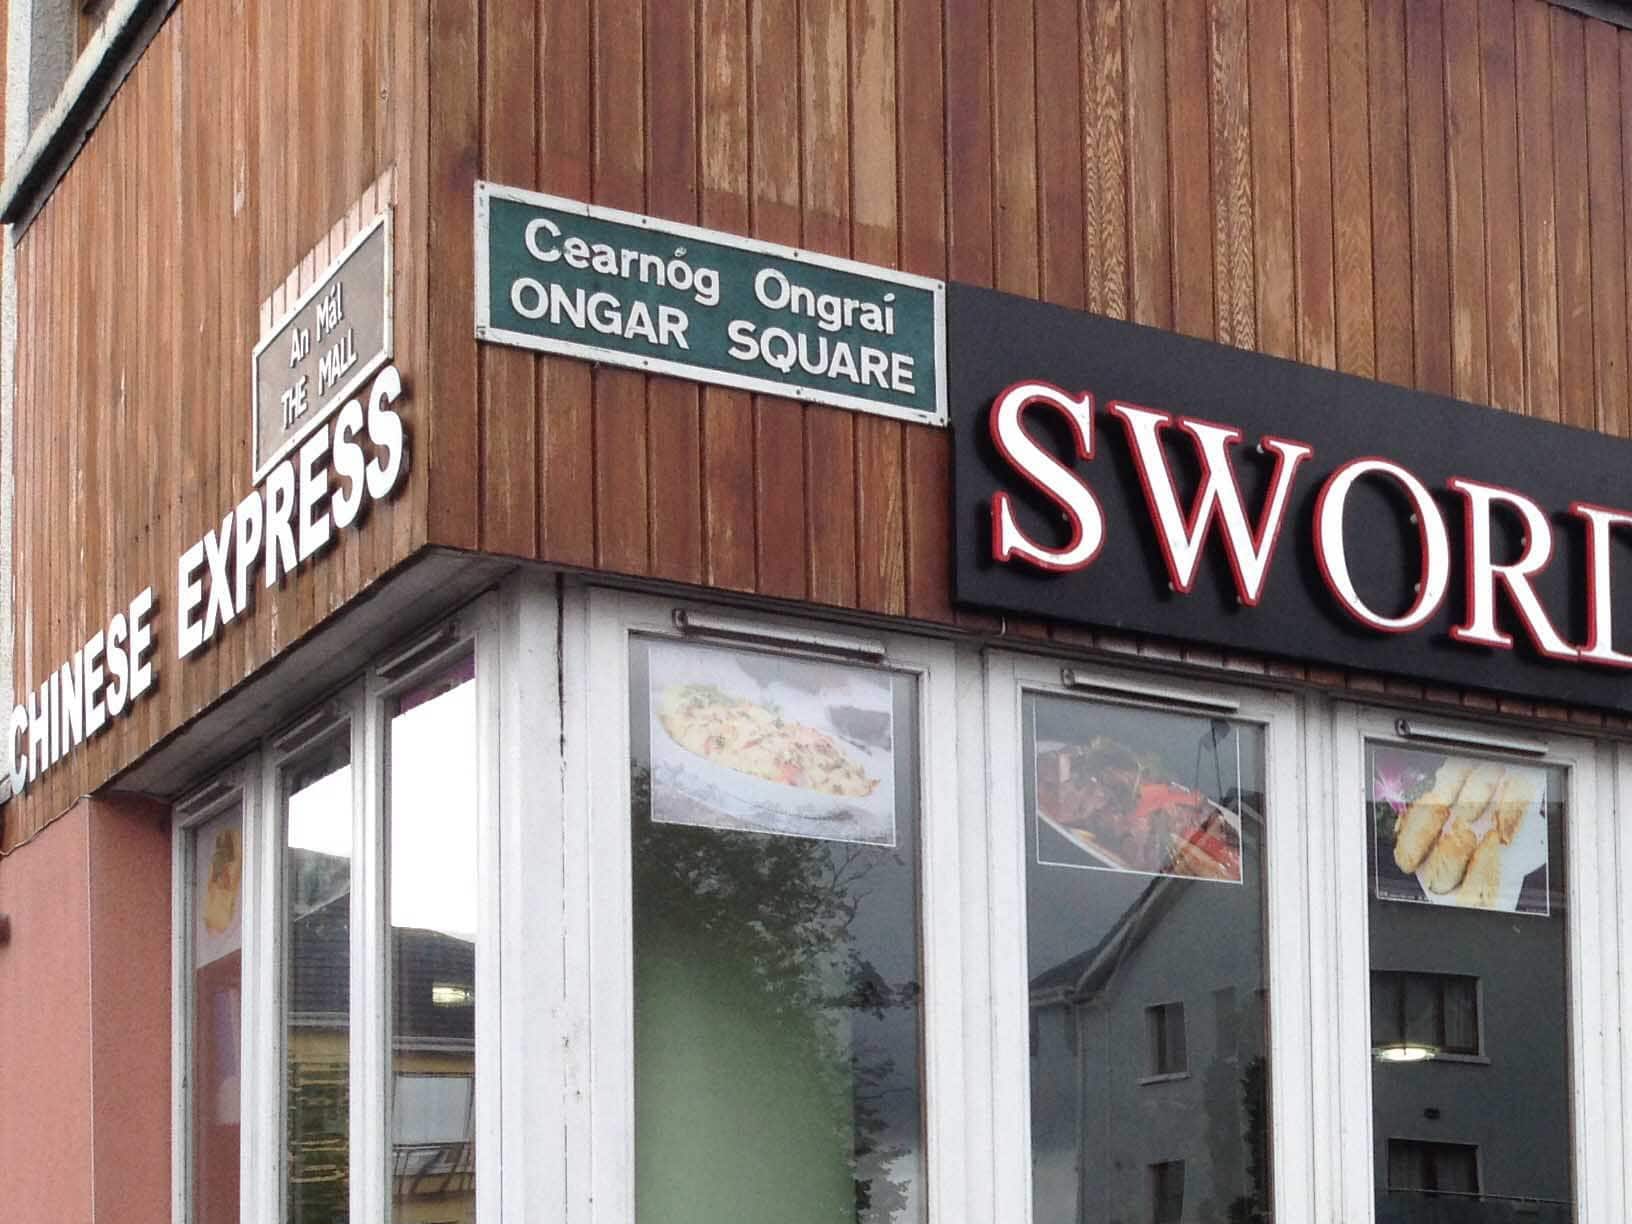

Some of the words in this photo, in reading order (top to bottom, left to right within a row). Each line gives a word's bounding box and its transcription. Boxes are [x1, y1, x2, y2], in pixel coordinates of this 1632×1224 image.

[290, 328, 310, 367] An
[316, 282, 343, 341] Mál
[525, 218, 720, 306] Cearnóg
[754, 269, 896, 335] Ongraí
[281, 376, 308, 430] THE
[318, 328, 357, 395] MALL
[510, 277, 689, 350] ONGAR
[727, 319, 916, 394] SQUARE
[9, 585, 153, 794] CHINESE
[178, 364, 403, 660] EXPRESS
